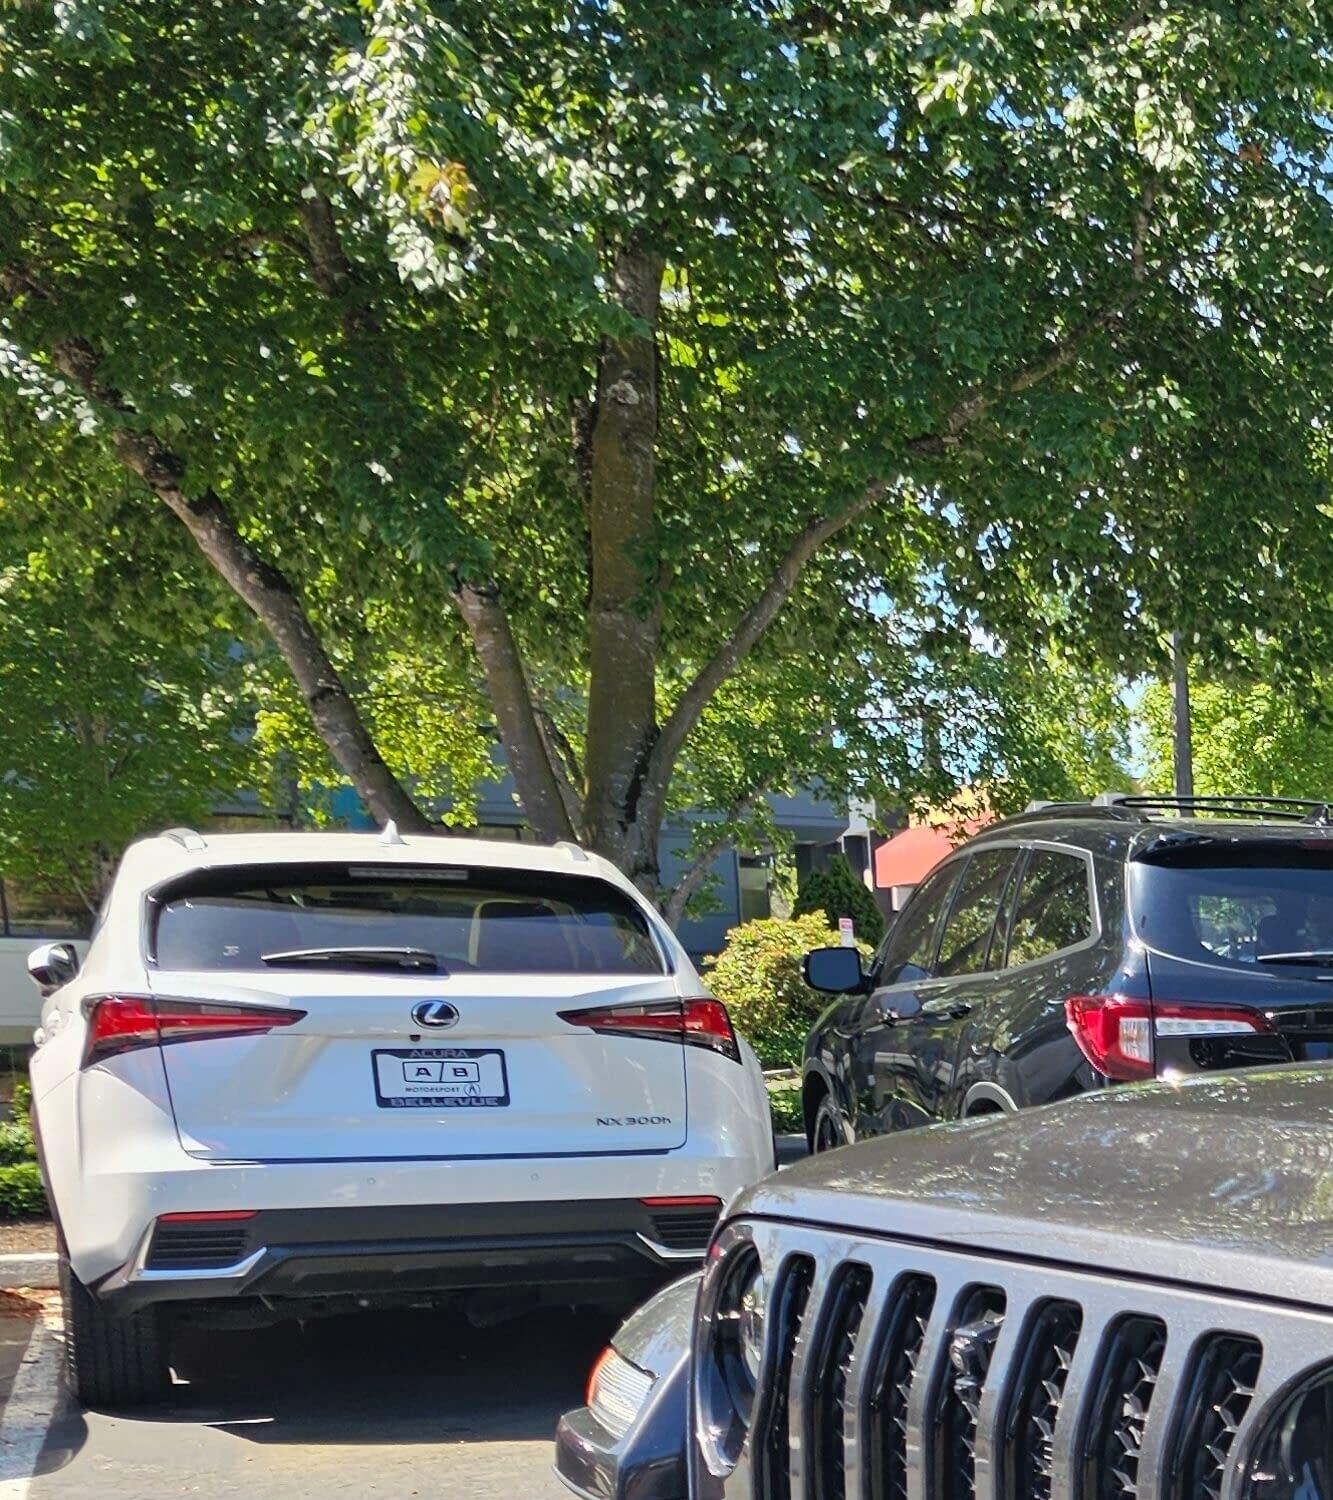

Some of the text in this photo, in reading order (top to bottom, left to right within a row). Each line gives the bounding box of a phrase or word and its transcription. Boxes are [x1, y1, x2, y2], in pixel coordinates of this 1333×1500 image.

[409, 1049, 469, 1058] ACURA
[415, 1067, 469, 1077] A B
[390, 1098, 499, 1107] BELLEVUE
